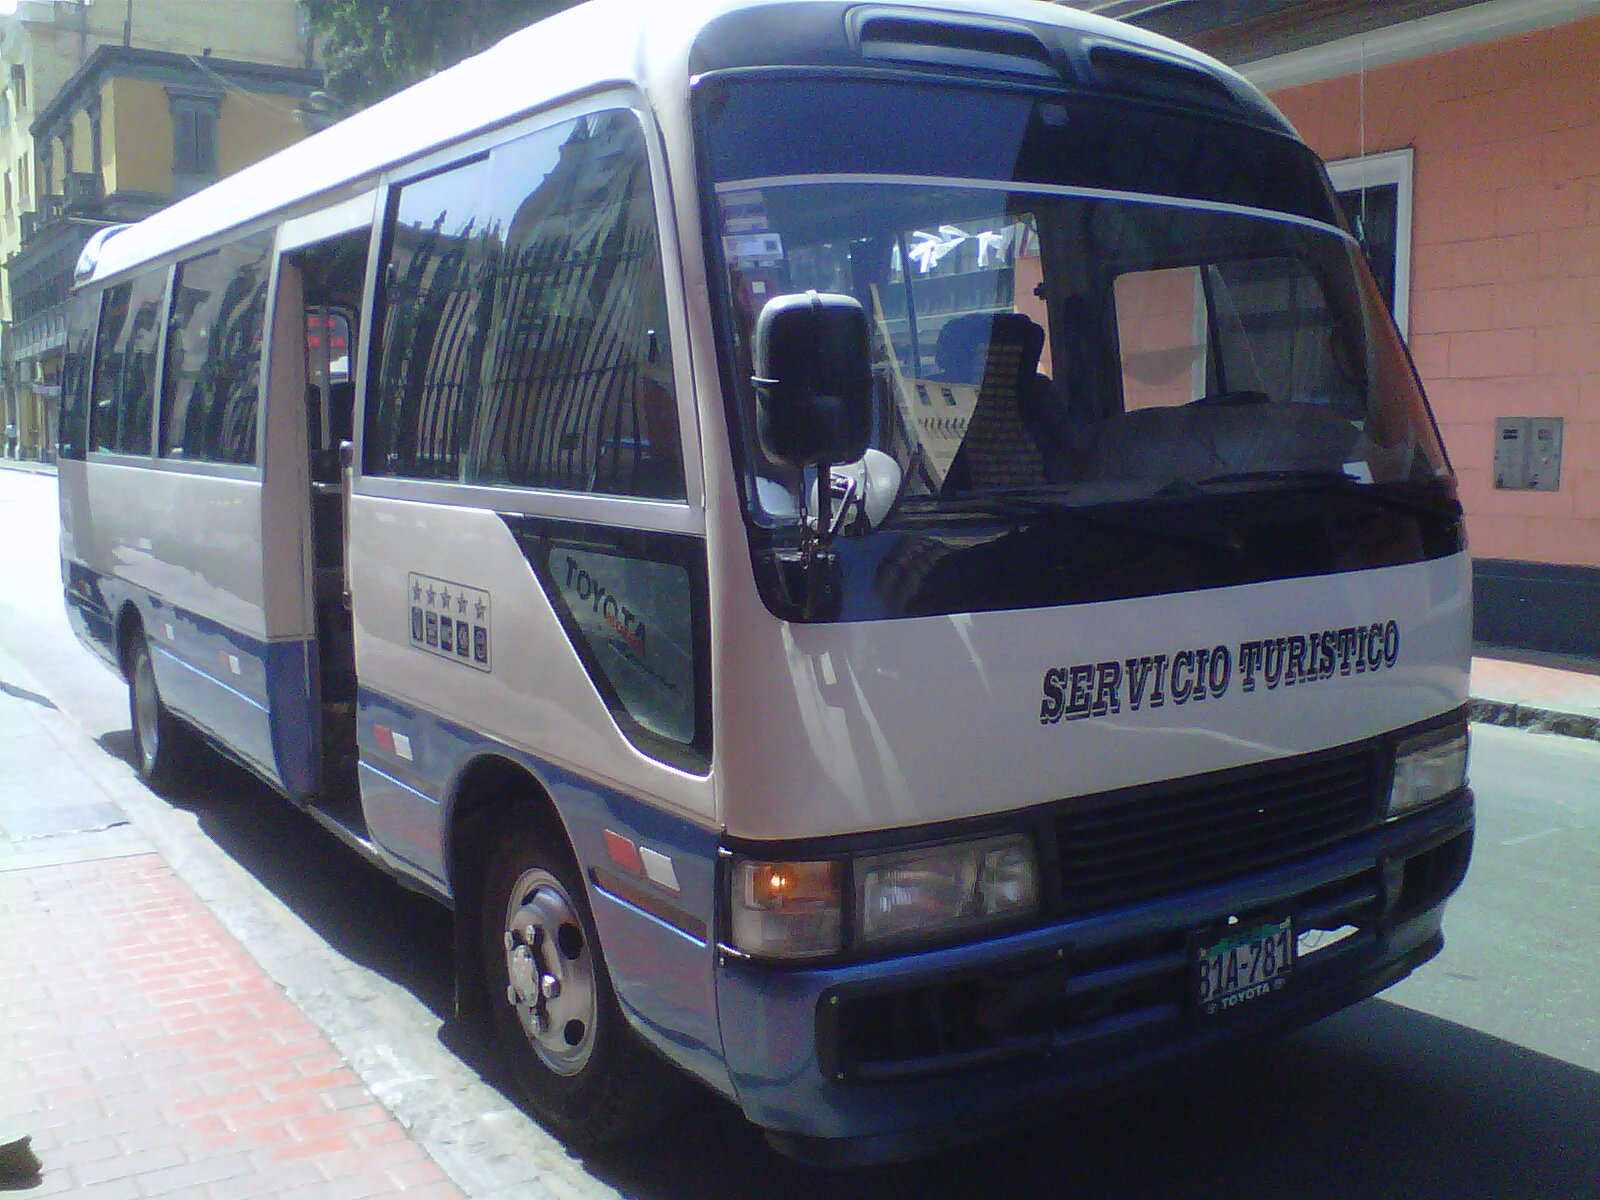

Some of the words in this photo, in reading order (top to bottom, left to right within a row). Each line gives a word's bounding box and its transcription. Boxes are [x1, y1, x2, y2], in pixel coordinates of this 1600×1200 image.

[565, 555, 646, 656] TOYOTA
[1040, 644, 1233, 725] SERVICIO
[1239, 620, 1400, 692] TURISTICO
[1221, 982, 1271, 1010] TOYOTA
